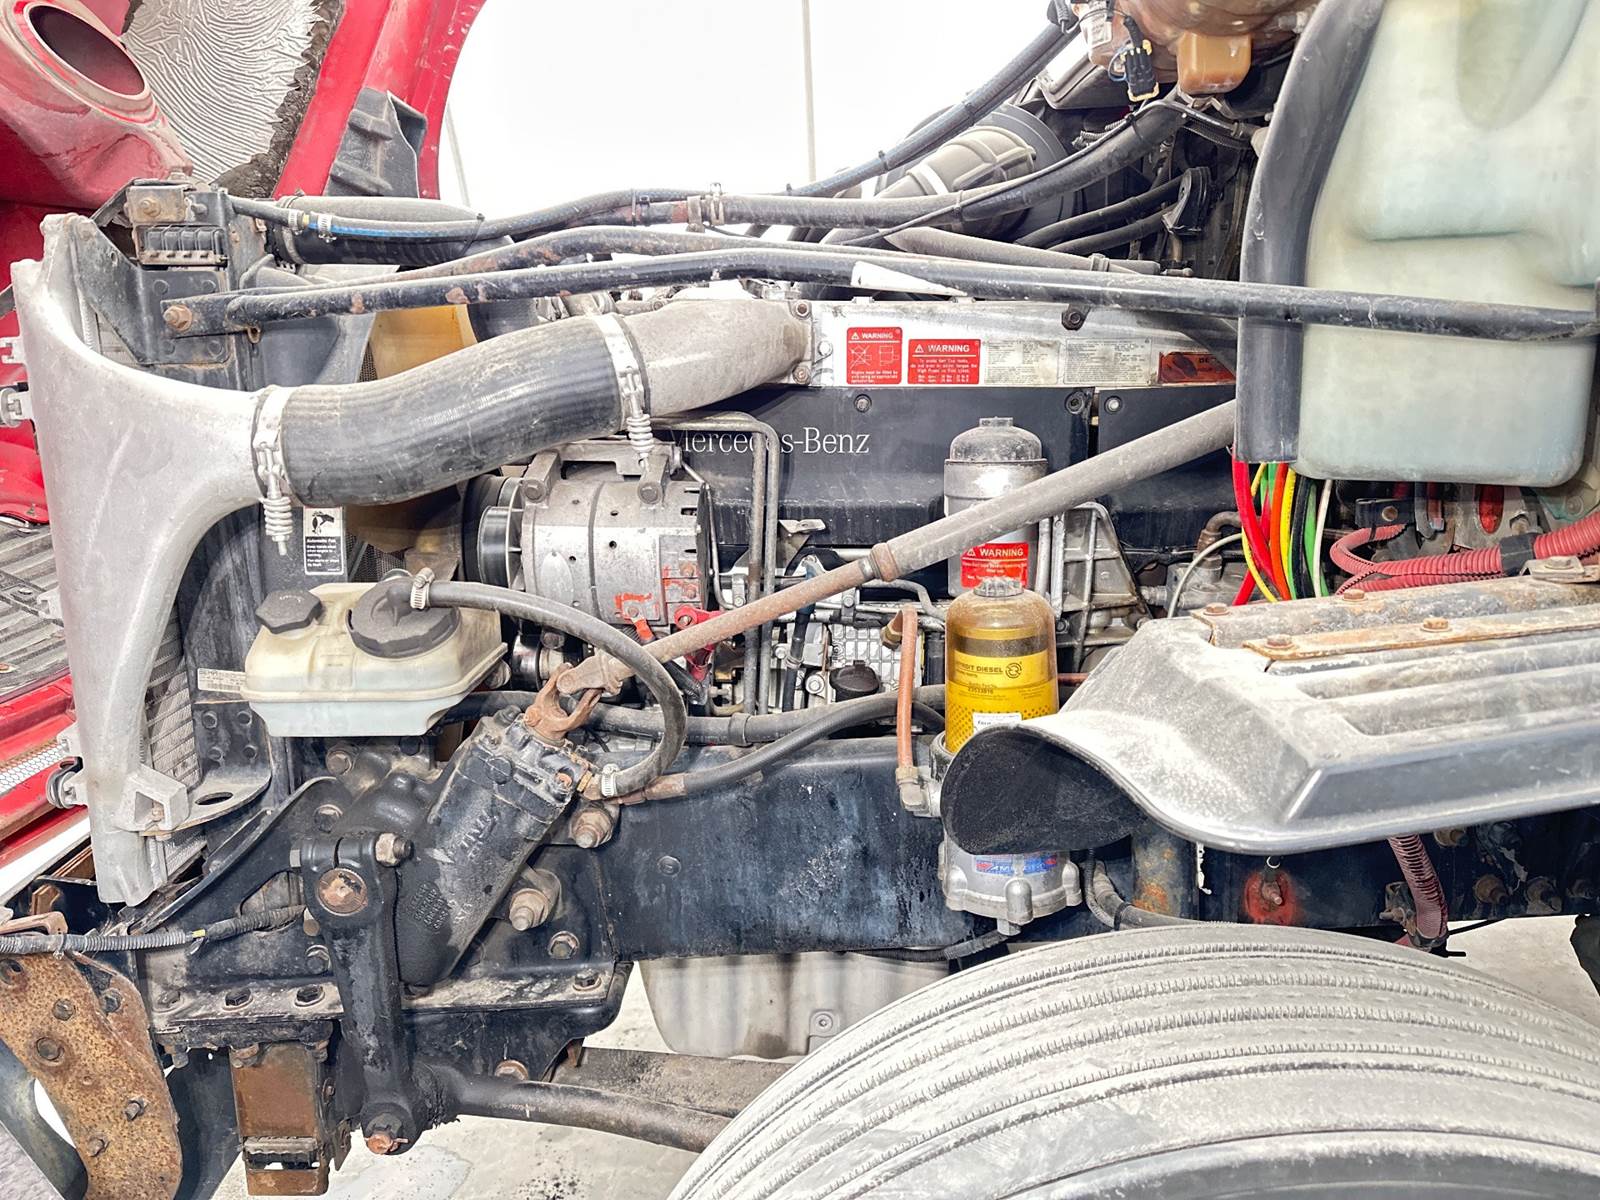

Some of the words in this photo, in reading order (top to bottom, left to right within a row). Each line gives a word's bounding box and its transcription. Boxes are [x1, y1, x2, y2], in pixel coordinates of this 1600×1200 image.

[928, 344, 970, 352] WARNING
[979, 547, 1024, 556] WARNING
[976, 665, 1003, 673] DIESEL
